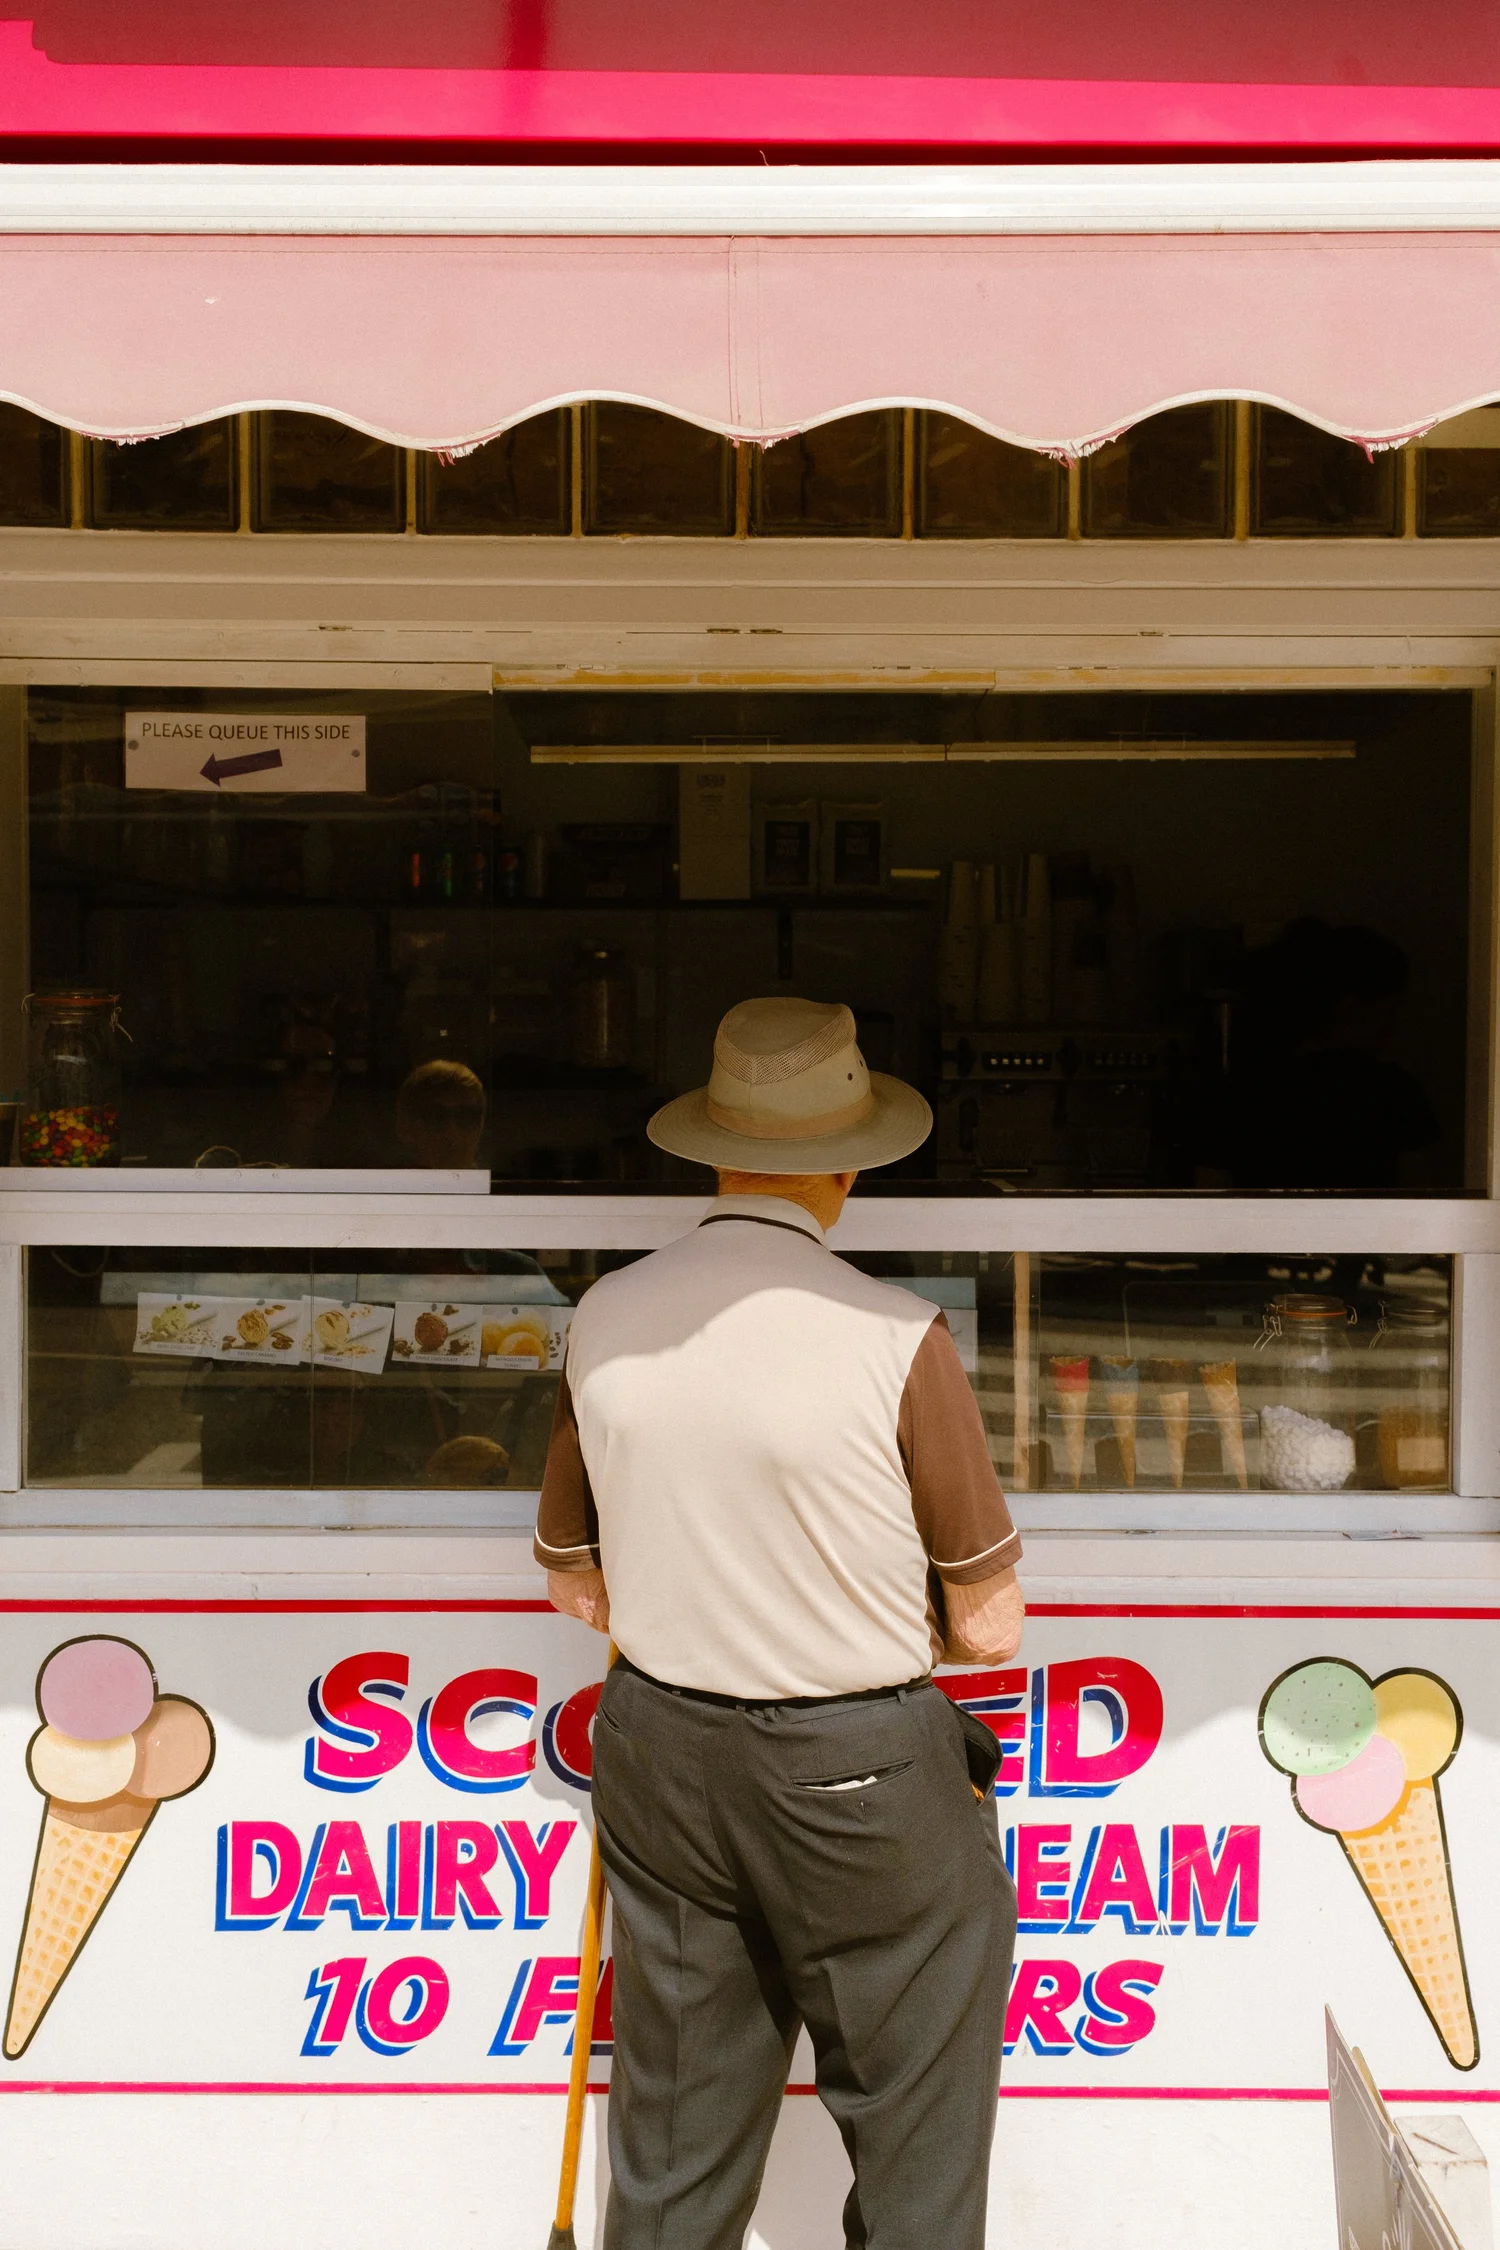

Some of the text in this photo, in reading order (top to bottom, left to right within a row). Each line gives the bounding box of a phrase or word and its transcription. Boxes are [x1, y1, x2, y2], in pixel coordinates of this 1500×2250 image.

[142, 722, 350, 741] PLEASE QUEUE THIS SIDE
[214, 1820, 578, 1932] DAIRY
[300, 1956, 450, 2056] 10
